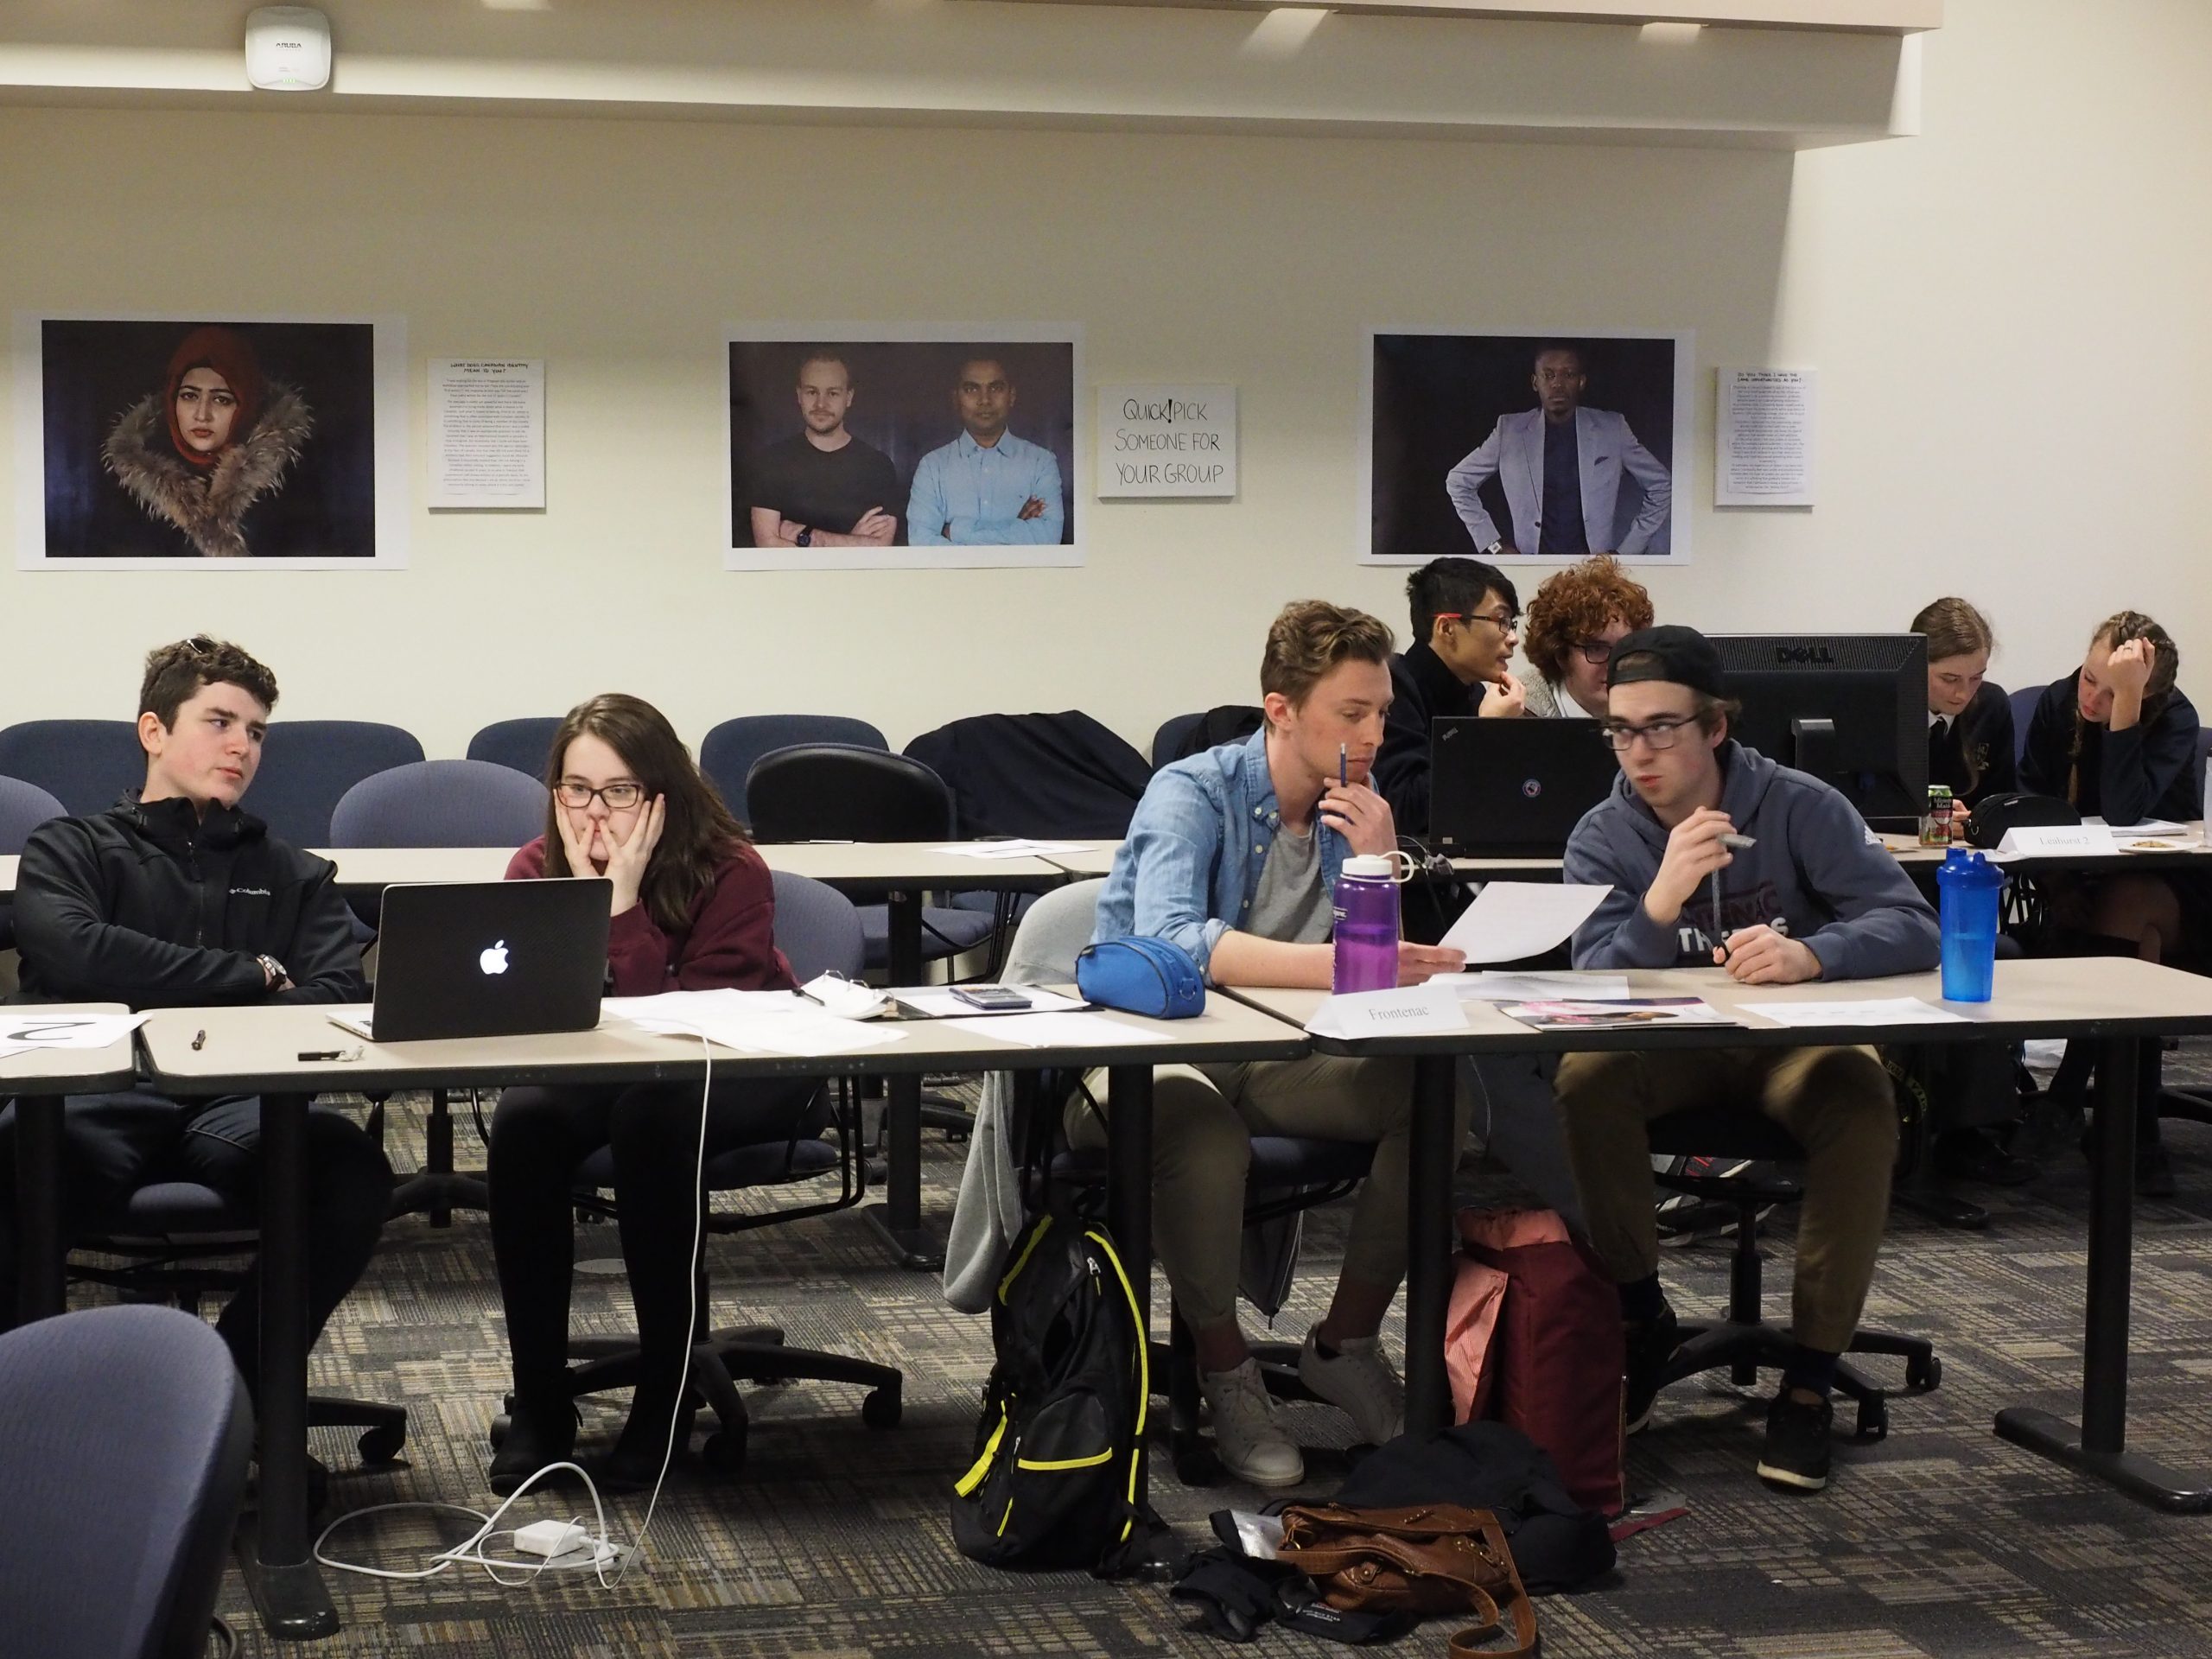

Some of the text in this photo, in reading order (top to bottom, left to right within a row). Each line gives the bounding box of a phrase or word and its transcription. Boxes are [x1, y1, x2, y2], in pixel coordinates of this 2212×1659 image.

[1122, 398, 1208, 423] QUICK! PICK
[1115, 428, 1221, 451] SOMEONE FOR
[1116, 462, 1224, 486] YOUR GROUP
[1776, 646, 1834, 664] DELL
[2039, 836, 2081, 845] Leahurst
[236, 887, 271, 896] Columbia
[1368, 1005, 1430, 1020] Frontenac
